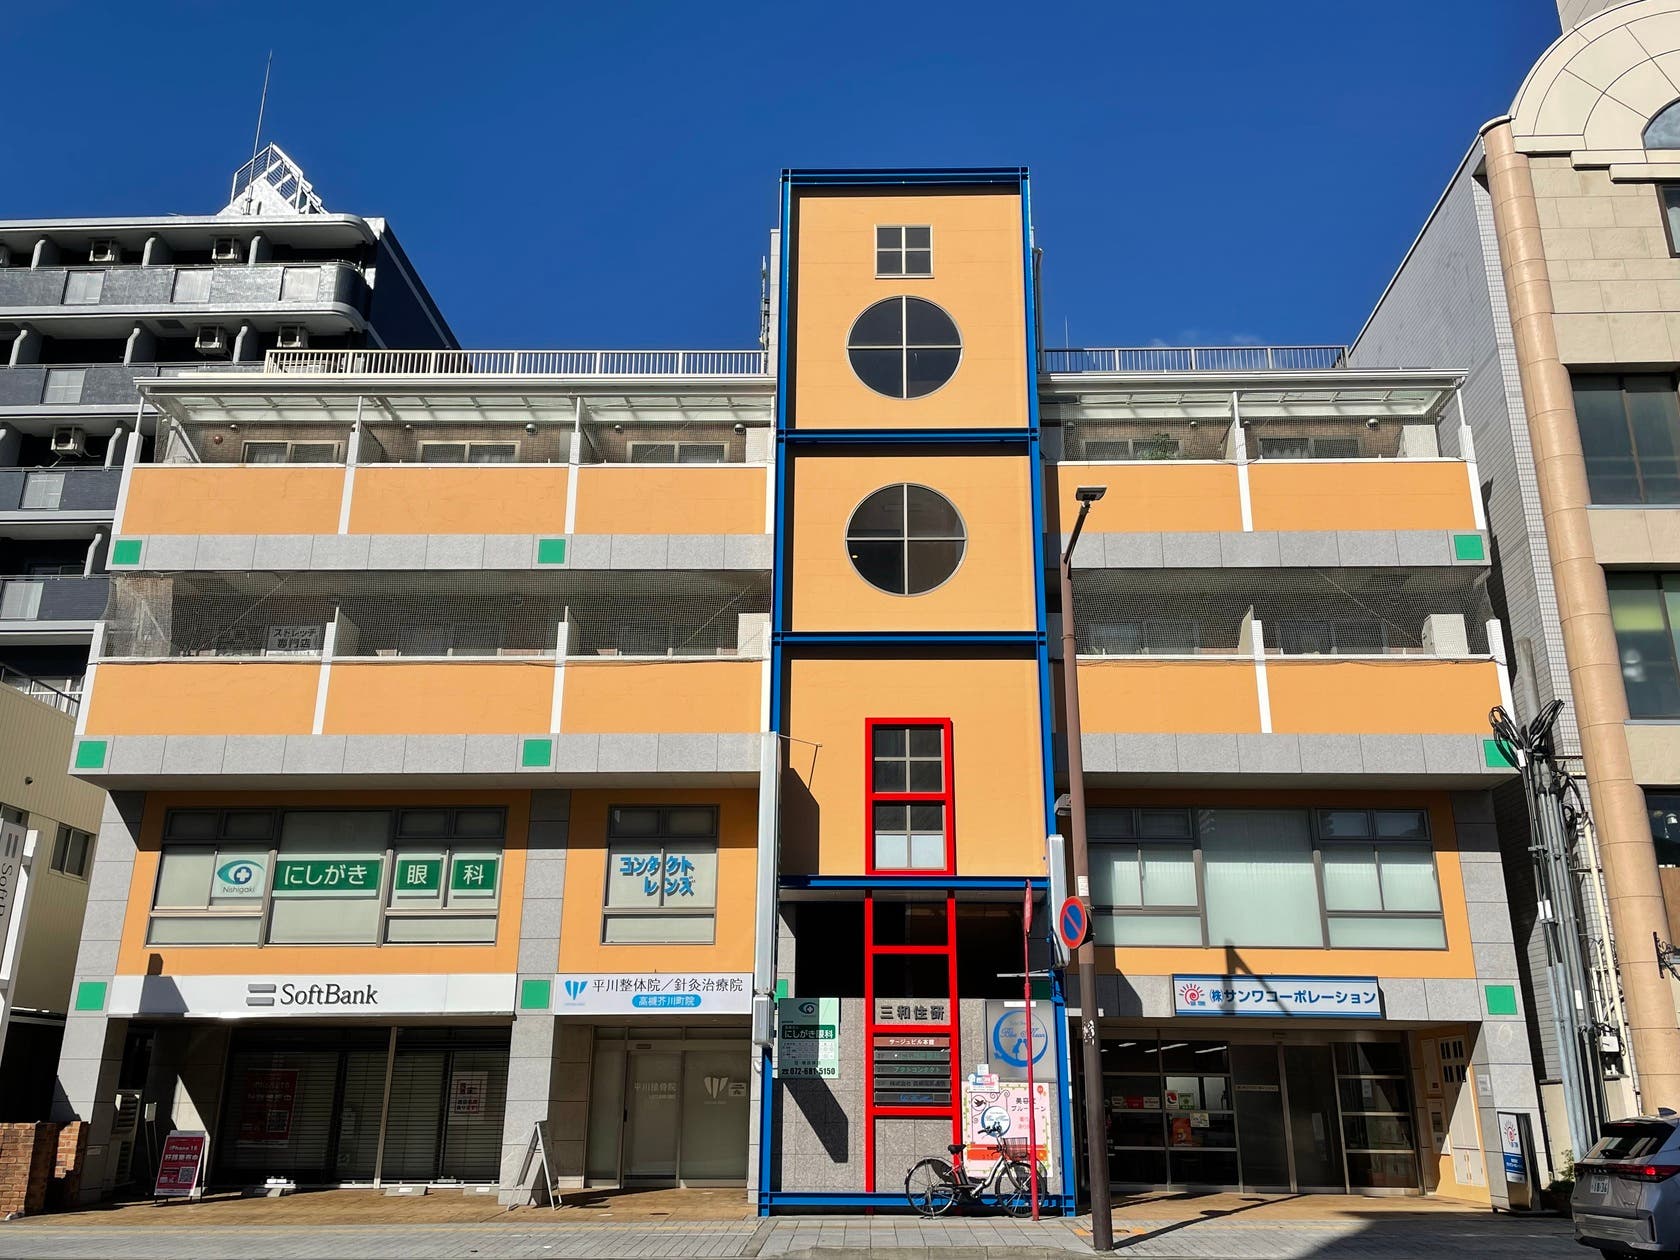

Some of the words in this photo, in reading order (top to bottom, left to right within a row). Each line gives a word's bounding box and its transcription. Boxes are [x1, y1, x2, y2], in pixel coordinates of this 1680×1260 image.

[619, 855, 695, 876] コンタクト
[284, 864, 368, 886] にしがき
[406, 864, 427, 885] 眼
[463, 864, 484, 886] 科
[222, 886, 256, 894] Nishigaki
[643, 876, 695, 897] レンズ
[280, 983, 379, 1005] SoftBank
[638, 996, 695, 1007] 高槻芥川町院
[880, 1005, 945, 1021] 三和住研
[784, 1029, 834, 1039] にしがき眼科
[789, 1067, 836, 1076] 072-681-5150
